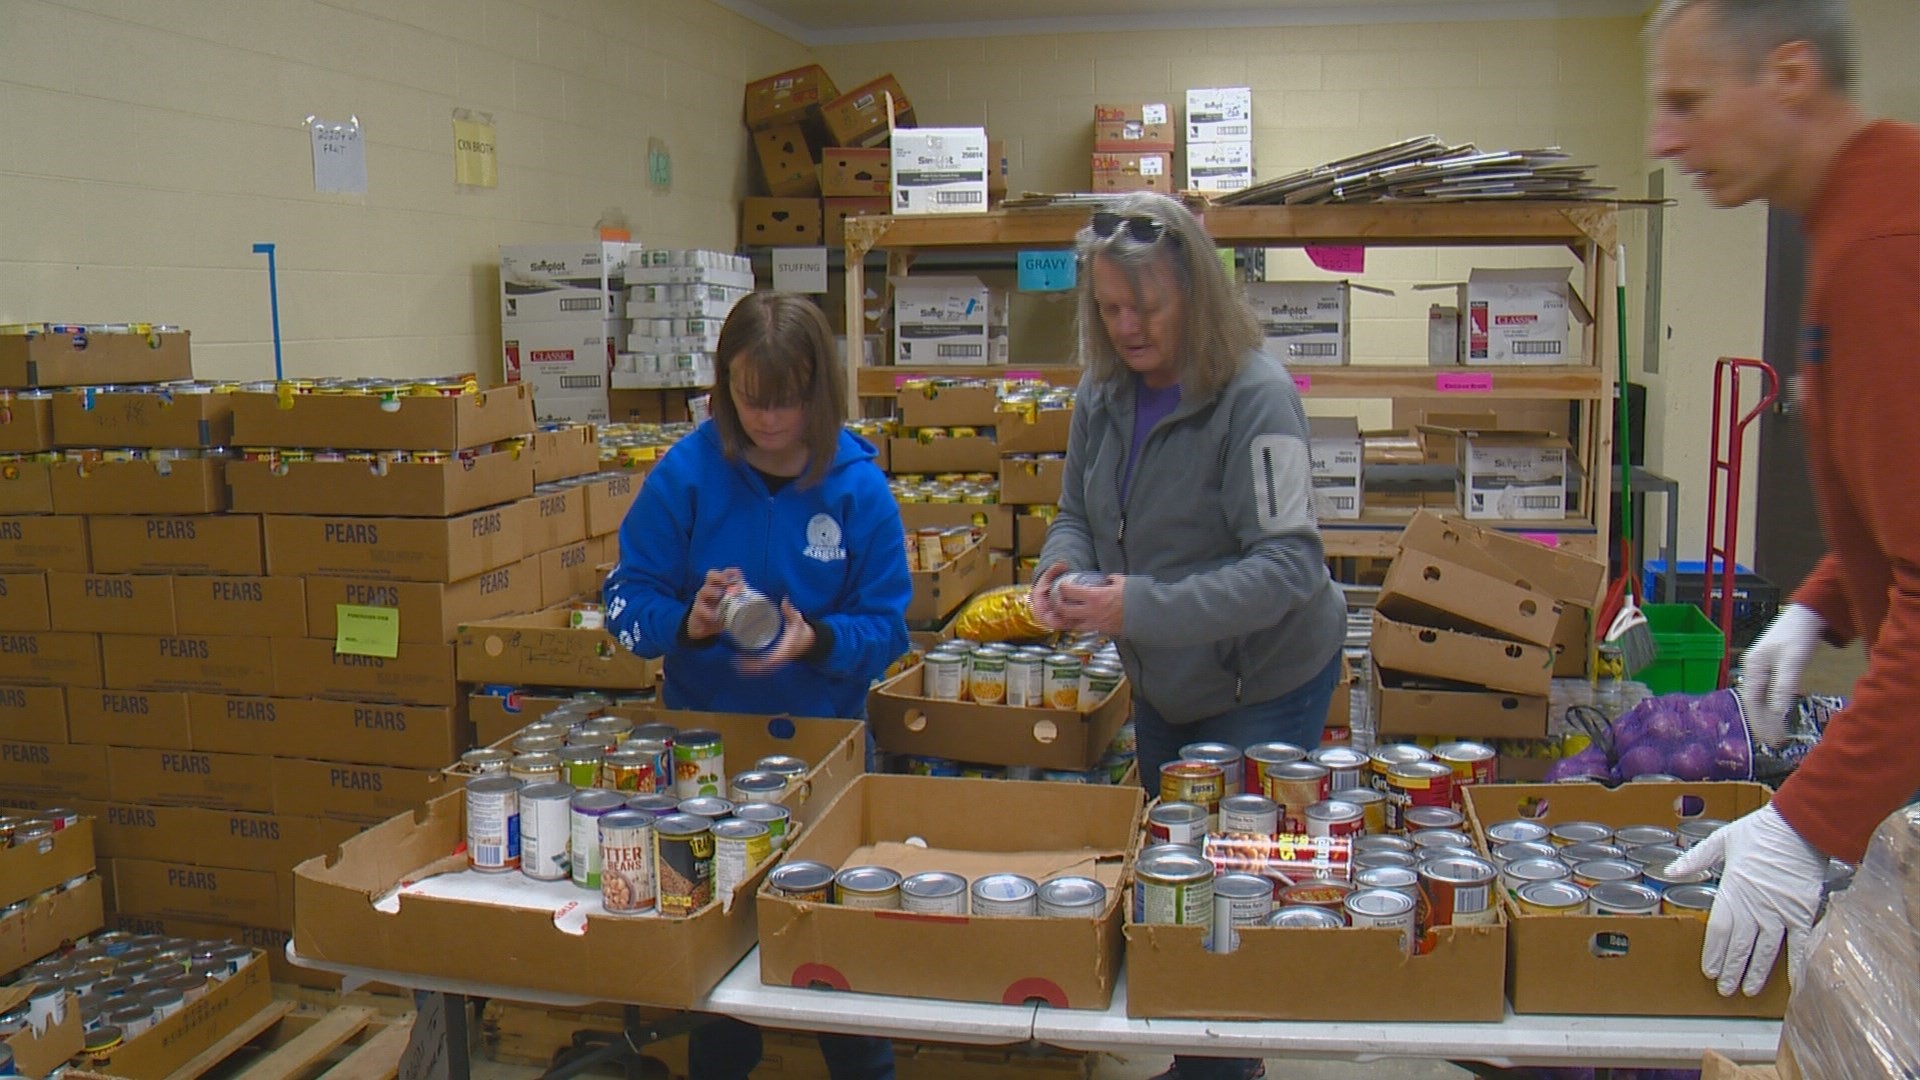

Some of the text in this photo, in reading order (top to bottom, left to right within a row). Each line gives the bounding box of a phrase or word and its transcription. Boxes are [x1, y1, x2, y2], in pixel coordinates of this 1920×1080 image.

[530, 260, 566, 273] Simplot
[779, 263, 820, 272] STUFFING
[1025, 258, 1067, 270] GRAVY
[920, 306, 945, 319] Simp
[1271, 304, 1308, 317] Simplot
[532, 351, 571, 361] CLASSIC
[540, 495, 566, 517] PEARS
[147, 520, 196, 540] PEARS
[325, 523, 378, 544] PEARS
[472, 513, 501, 538] PEARS
[561, 546, 586, 569] PEARS
[85, 578, 134, 599] PEARS
[212, 581, 263, 601] PEARS
[480, 570, 509, 596] PEARS
[346, 584, 399, 606] PEARS
[1, 635, 38, 654] EARS
[160, 638, 209, 659] PEARS
[102, 694, 149, 715] PEARS
[227, 700, 276, 722] PEARS
[354, 708, 407, 732] PEARS
[2, 744, 50, 764] PEARS
[161, 753, 211, 775] PEARS
[331, 769, 383, 792] PEARS
[108, 807, 156, 828] PEARS
[230, 818, 280, 840] PEARS
[607, 861, 642, 872] BEANS
[168, 868, 217, 891] PEARS
